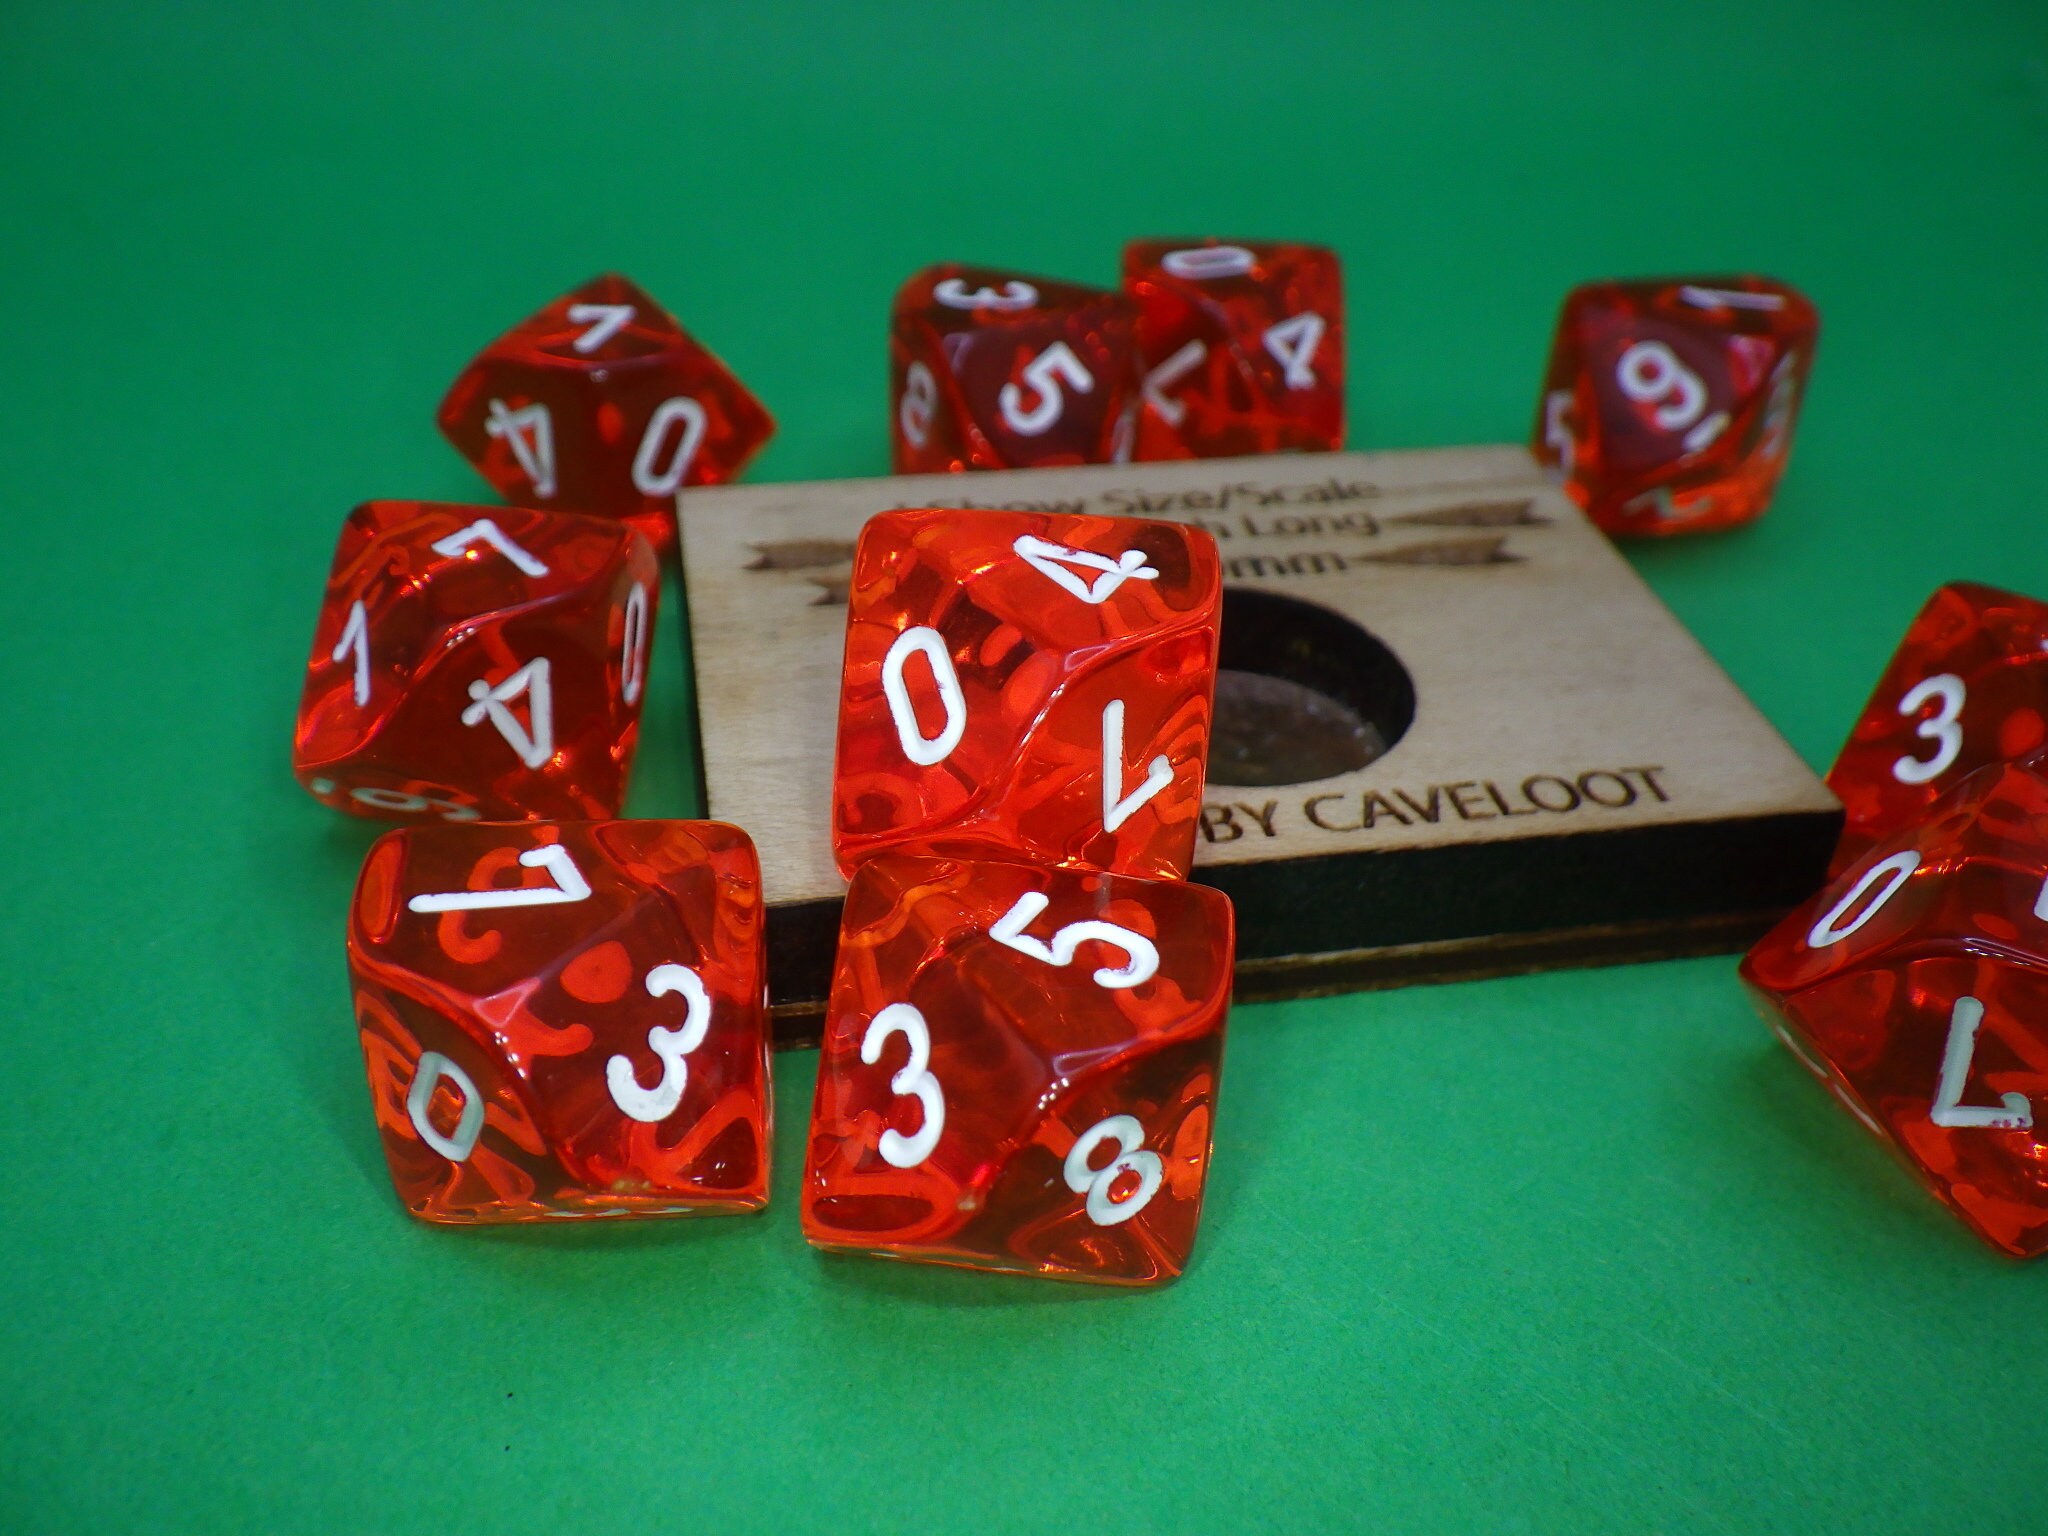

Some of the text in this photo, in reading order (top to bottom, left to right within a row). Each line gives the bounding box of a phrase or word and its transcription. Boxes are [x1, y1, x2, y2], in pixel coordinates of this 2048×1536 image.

[932, 278, 1039, 312] 3
[1160, 245, 1257, 280] 0
[999, 340, 1094, 437] 5
[1262, 311, 1326, 390] 4
[1616, 341, 1707, 430] 9
[485, 397, 556, 496] 4
[631, 395, 708, 497] 0
[1102, 476, 1384, 516] Size/Scale
[1241, 511, 1382, 538] Long
[1013, 534, 1160, 604] 4
[1221, 552, 1348, 579] mm
[460, 655, 555, 769] 4
[881, 625, 967, 767] 0
[1893, 673, 1966, 785] 3
[1199, 765, 1672, 843] BY CAVELOOT
[988, 891, 1160, 989] 5
[1808, 850, 1920, 949] 0
[605, 963, 712, 1123] 3
[860, 1002, 946, 1169] 3
[1930, 996, 2033, 1129] 7
[406, 1050, 486, 1163] 0
[1062, 1114, 1164, 1227] 8
